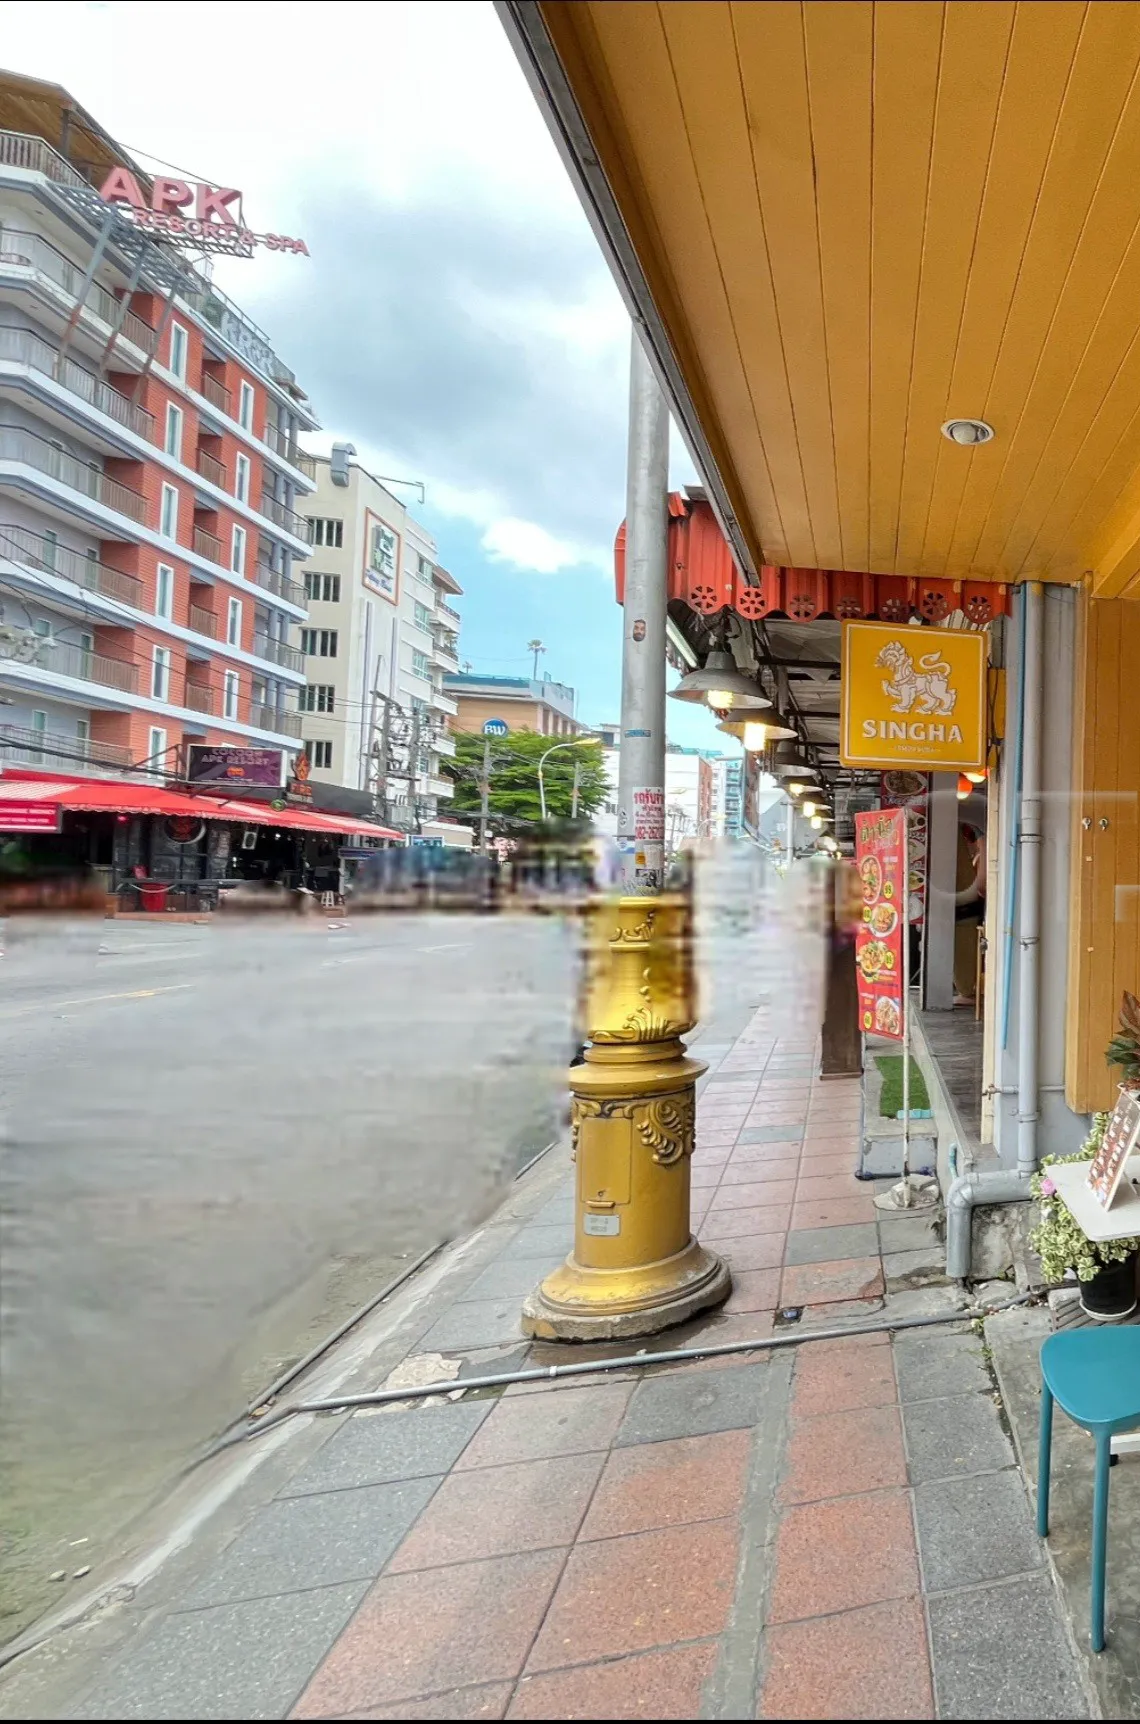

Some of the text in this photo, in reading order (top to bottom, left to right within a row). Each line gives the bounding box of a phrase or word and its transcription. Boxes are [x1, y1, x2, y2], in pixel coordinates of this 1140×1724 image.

[100, 165, 243, 226] APK
[133, 208, 311, 257] RESORT & SPA
[862, 719, 964, 744] SINGHA
